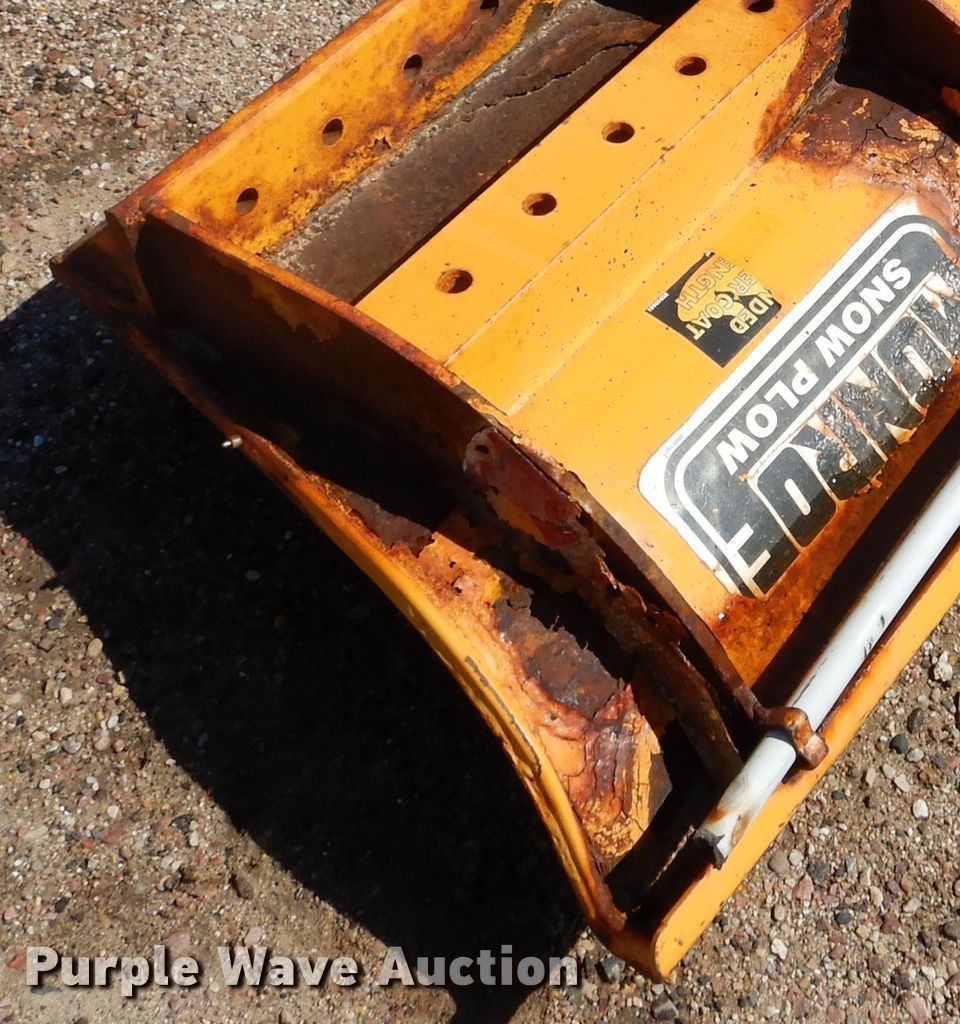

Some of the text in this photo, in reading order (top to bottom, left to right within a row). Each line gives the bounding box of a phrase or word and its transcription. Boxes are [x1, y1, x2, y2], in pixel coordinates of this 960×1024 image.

[685, 293, 734, 340] COAT
[715, 258, 912, 476] SNOW PLOW
